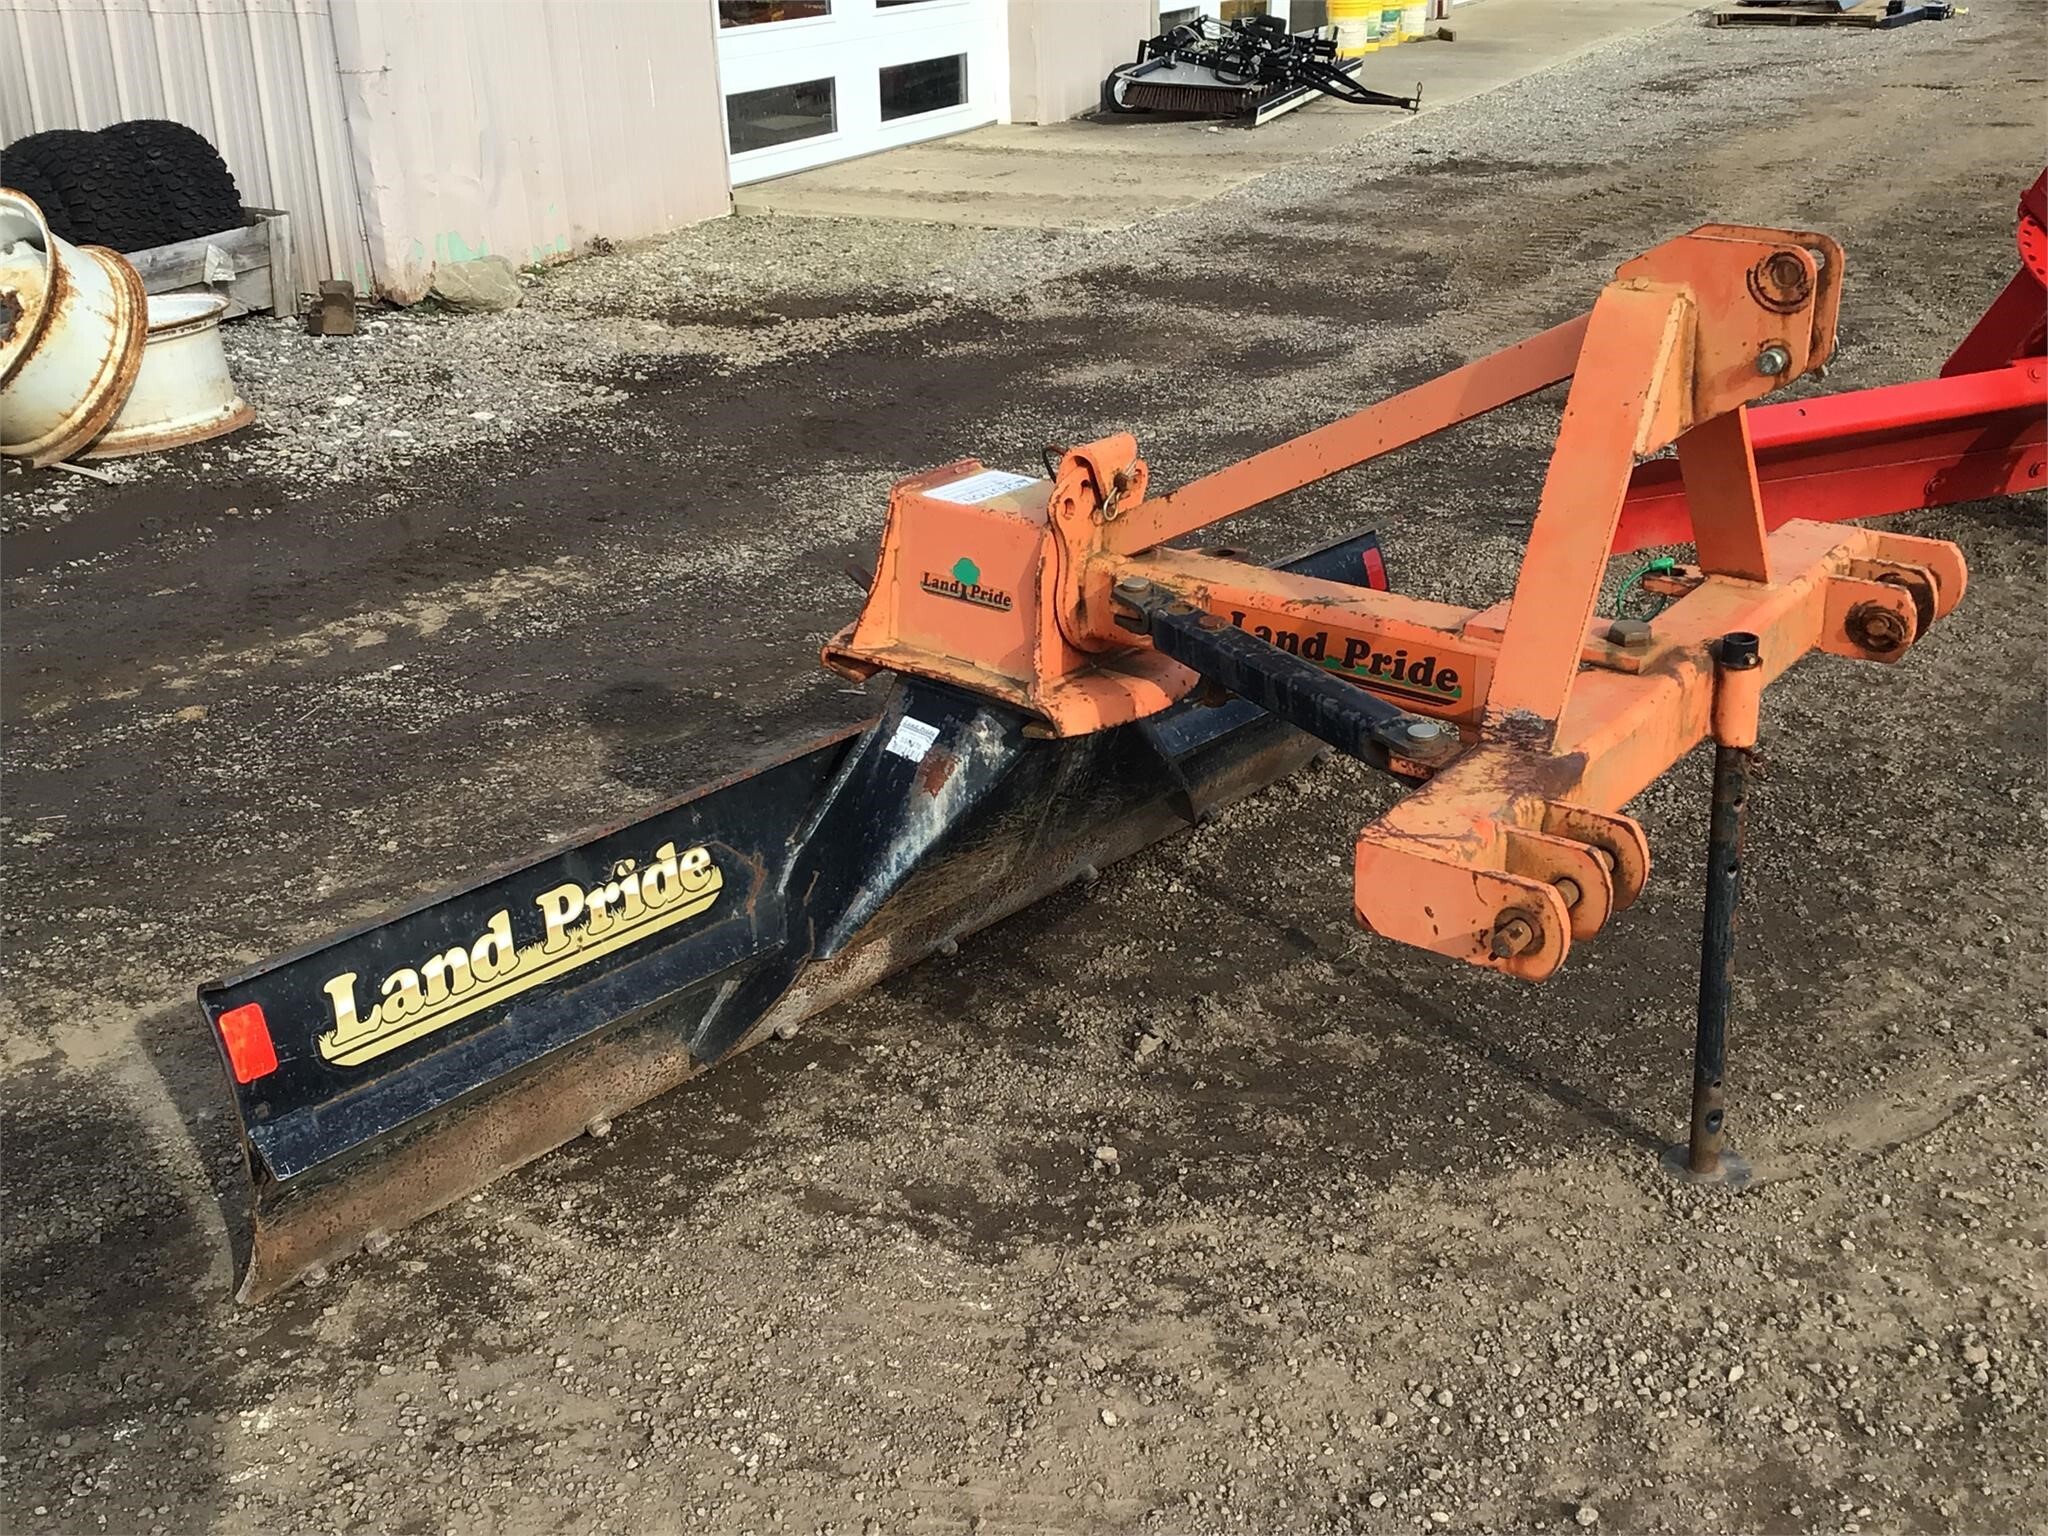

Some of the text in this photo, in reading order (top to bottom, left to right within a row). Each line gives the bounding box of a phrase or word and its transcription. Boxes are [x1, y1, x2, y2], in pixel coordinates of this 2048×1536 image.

[922, 572, 1012, 607] Land Pride
[1341, 637, 1459, 692] Pride
[323, 841, 715, 1046] Land Pride
